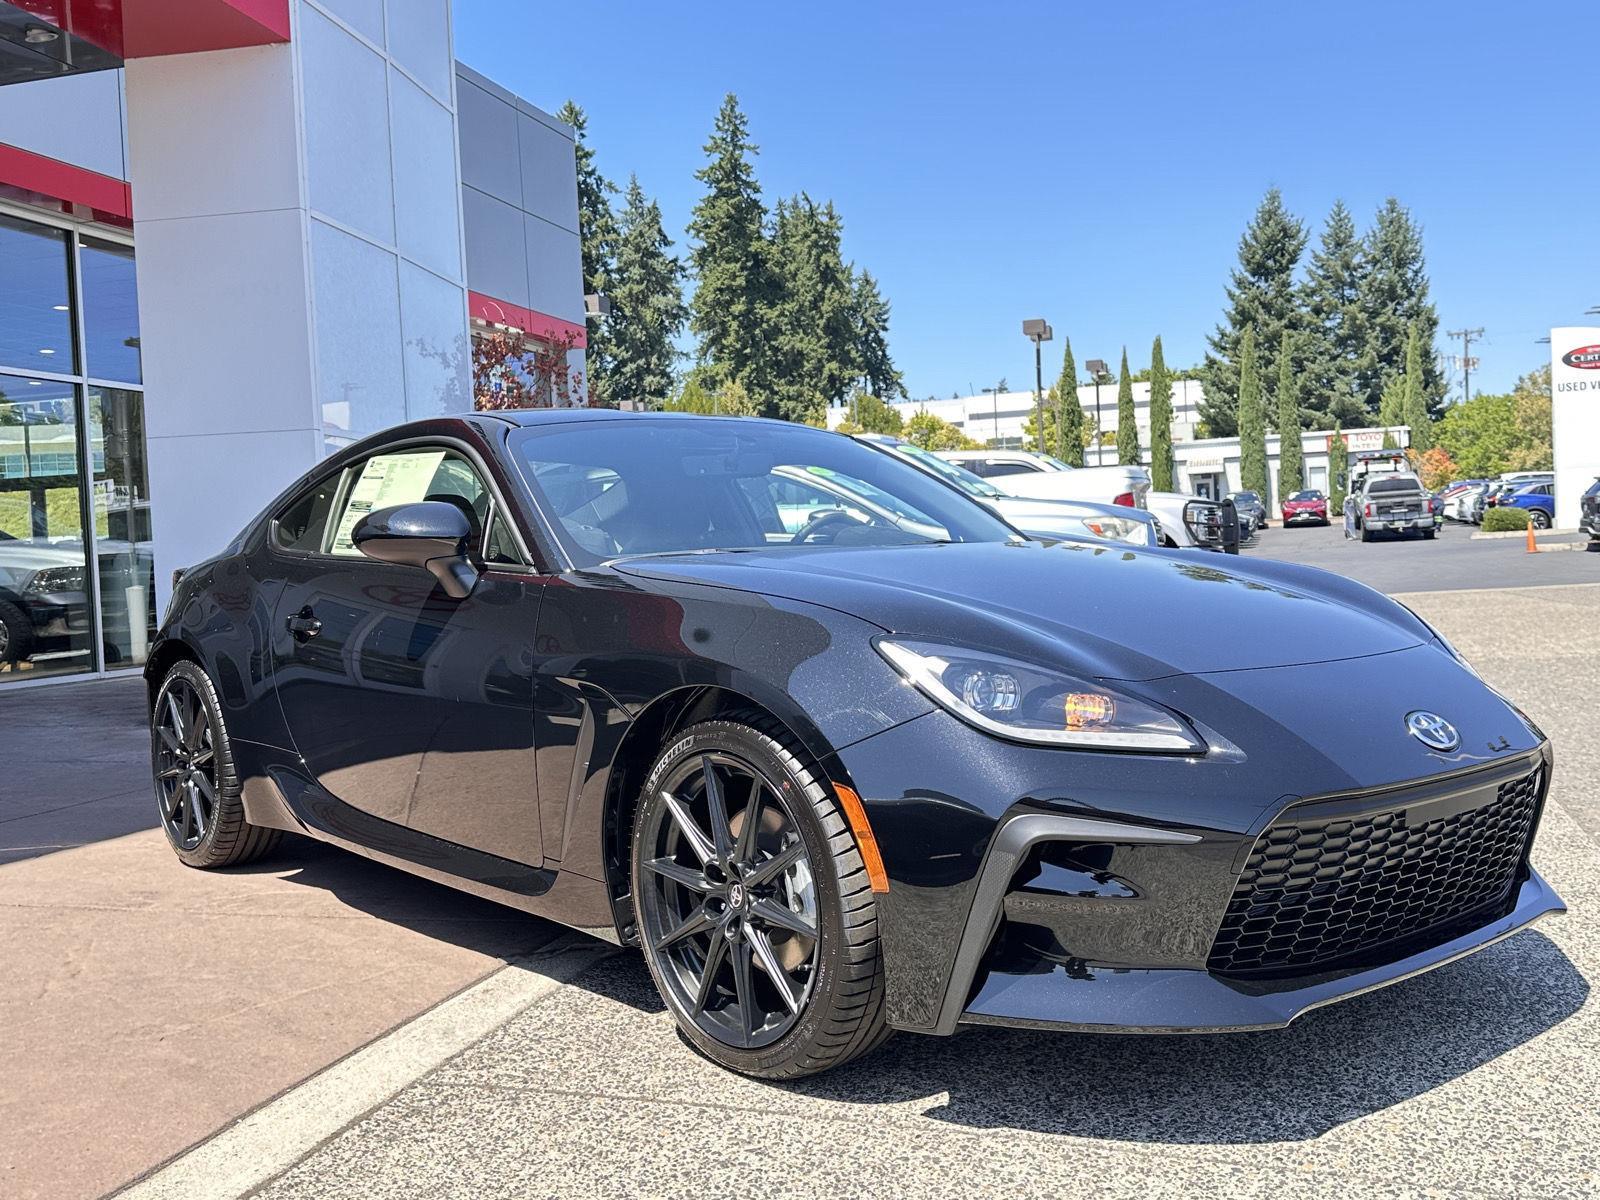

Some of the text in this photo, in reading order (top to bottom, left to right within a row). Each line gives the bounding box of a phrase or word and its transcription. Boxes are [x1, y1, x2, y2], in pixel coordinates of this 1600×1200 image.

[1571, 354, 1600, 362] CERT
[1558, 382, 1587, 392] USED
[1356, 433, 1381, 441] TOYO
[653, 738, 692, 777] MICHELIN
